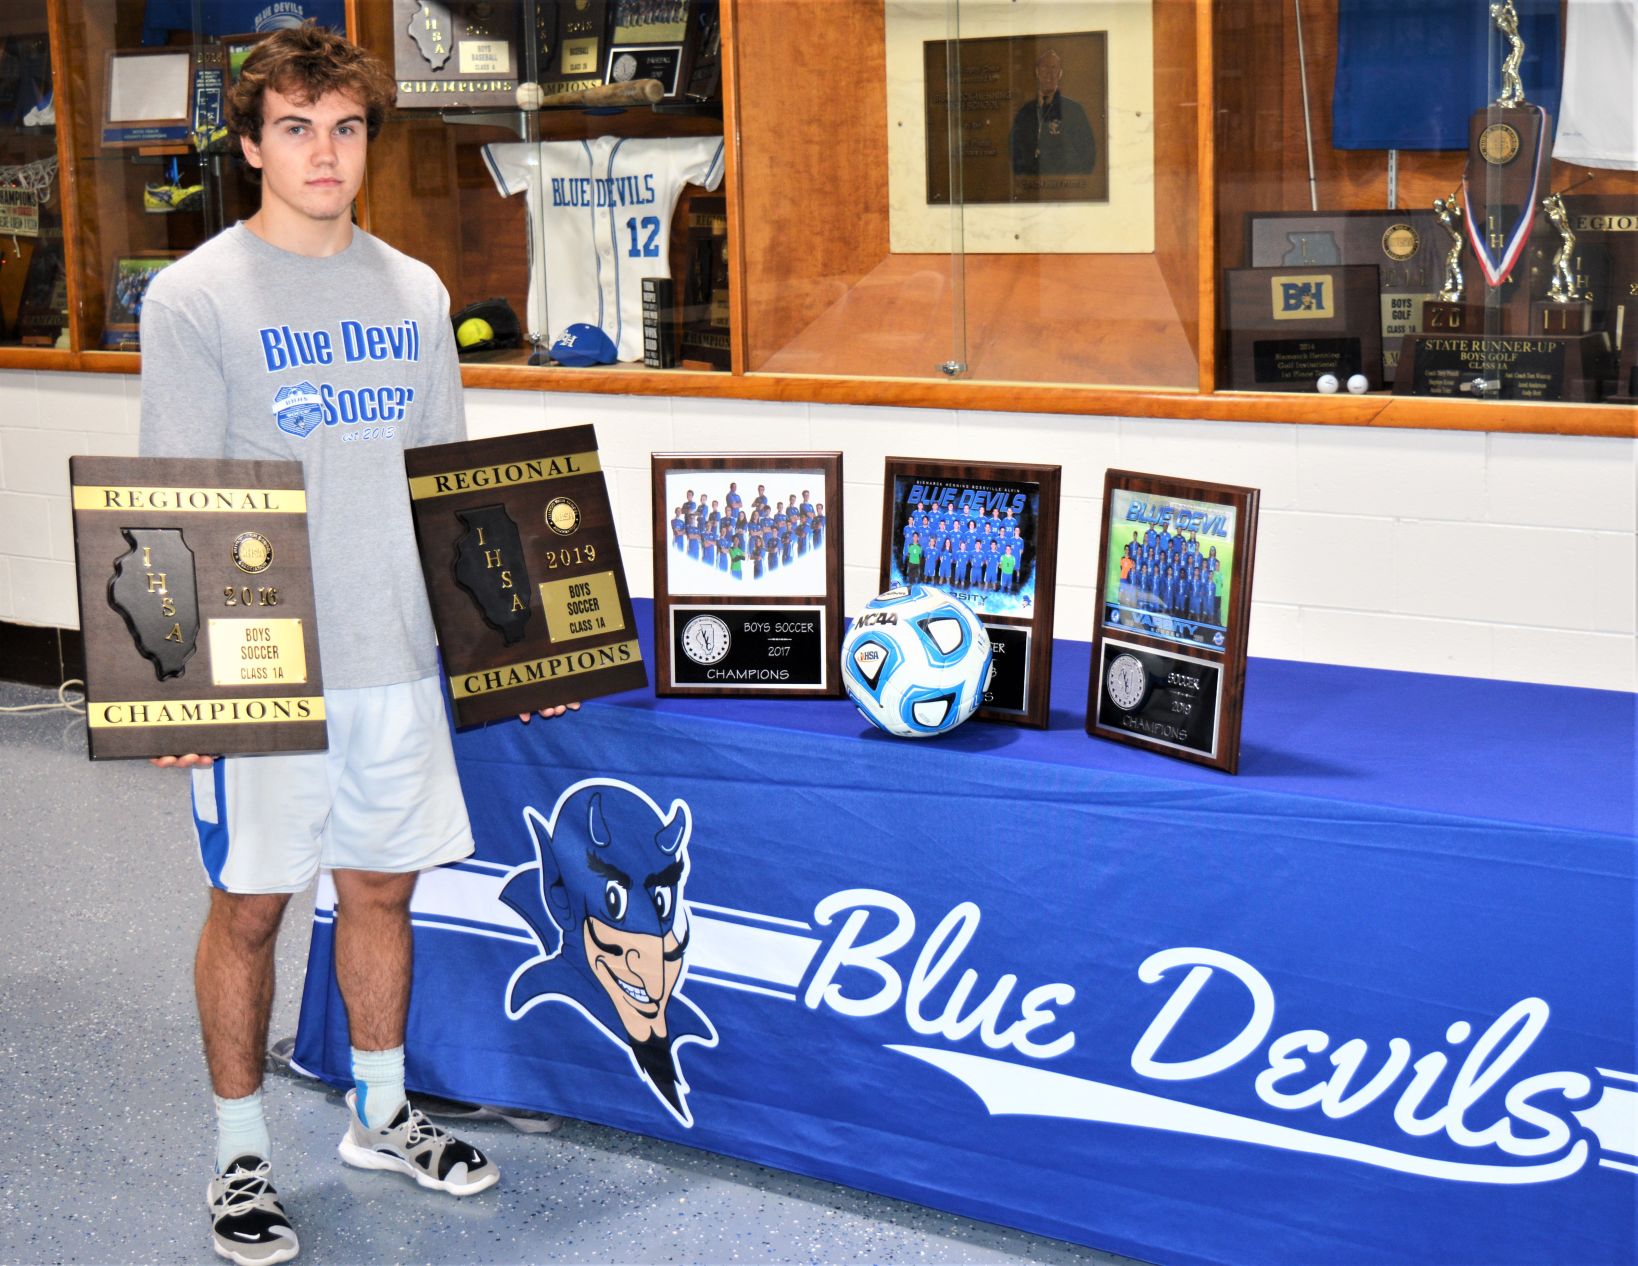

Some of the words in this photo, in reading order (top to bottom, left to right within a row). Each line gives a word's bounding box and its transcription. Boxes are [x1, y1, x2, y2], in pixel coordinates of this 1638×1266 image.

[274, 2, 304, 16] DEVILS
[400, 81, 512, 92] CHAMPIONS
[543, 80, 597, 95] MPIONS
[552, 178, 591, 207] BLUE
[596, 174, 656, 208] DEVILS
[1577, 217, 1638, 229] EGIO
[627, 216, 660, 258] 12
[1392, 299, 1412, 308] BOYS
[1392, 310, 1412, 320] GOLF
[1387, 326, 1406, 334] CLASS
[258, 325, 334, 373] Blue
[340, 319, 420, 363] Devil
[1424, 339, 1468, 351] STATE
[1472, 340, 1557, 353] RUNNER-UP
[1460, 352, 1486, 361] BOYS
[1488, 352, 1518, 362] GOLF
[1469, 362, 1495, 370] CLASS
[320, 382, 416, 427] Soccer
[434, 456, 580, 493] REGIONAL
[103, 489, 280, 510] REGIONAL
[908, 484, 957, 506] BLUE
[958, 490, 1026, 514] DEVILS
[1126, 500, 1174, 526] BLUE
[1176, 509, 1227, 537] DEVIL
[546, 544, 596, 569] 2019
[143, 547, 184, 644] IHSA
[224, 586, 278, 606] 2016
[568, 582, 591, 599] BOYS
[567, 598, 600, 616] SOCCER
[569, 621, 594, 634] CLASS
[596, 618, 606, 630] 1A
[744, 622, 770, 633] BOYS
[775, 622, 814, 633] SOCCER
[854, 612, 898, 630] NCAA
[246, 628, 272, 642] BOYS
[241, 645, 280, 660] SOCCER
[768, 646, 790, 657] 2017
[240, 667, 267, 680] CLASS
[273, 666, 284, 679] 1A
[464, 643, 632, 694] CHAMPIONS
[707, 669, 790, 680] CHAMPIONS
[1168, 672, 1200, 690] SOCCER
[104, 700, 312, 724] CHAMPIONS
[1122, 715, 1188, 740] CHAMPIONS
[805, 888, 1076, 1058] Blue
[1131, 947, 1592, 1156] Devils
